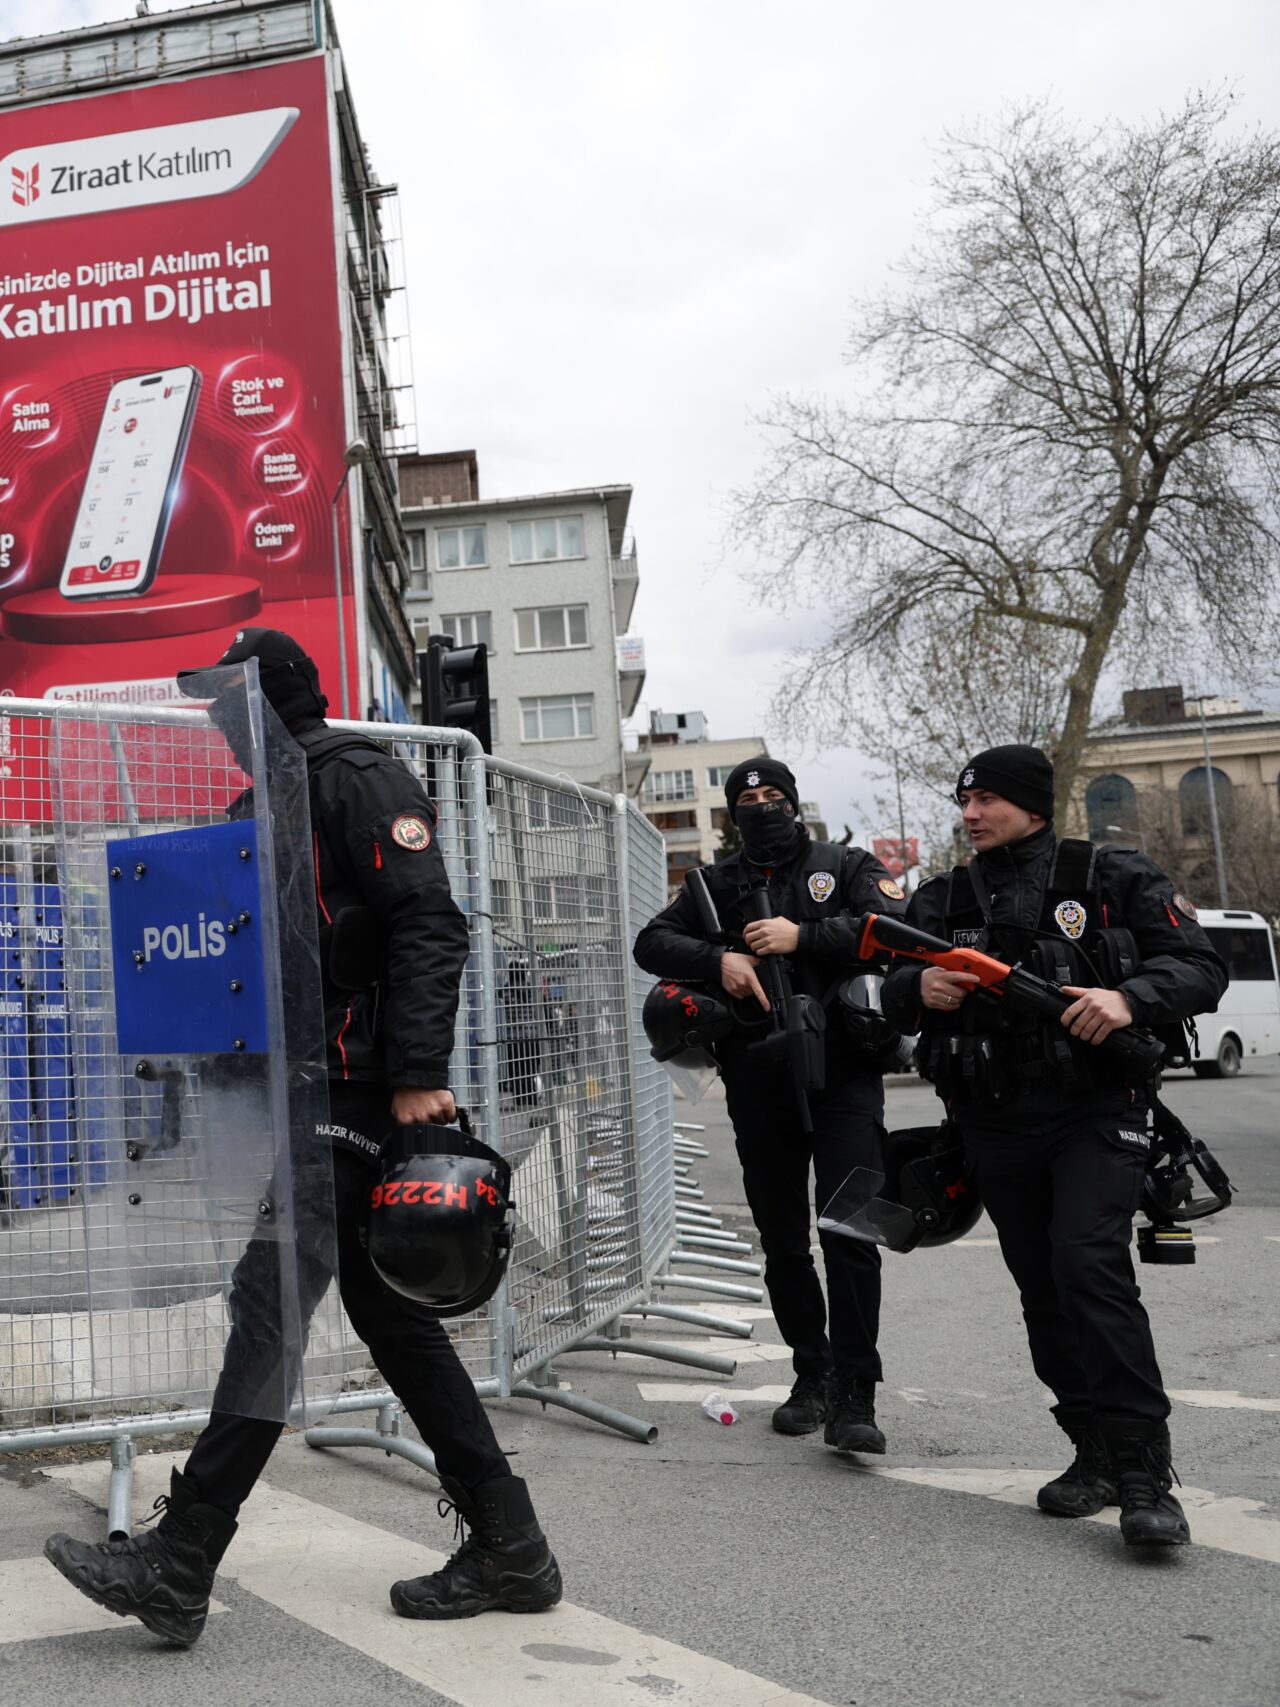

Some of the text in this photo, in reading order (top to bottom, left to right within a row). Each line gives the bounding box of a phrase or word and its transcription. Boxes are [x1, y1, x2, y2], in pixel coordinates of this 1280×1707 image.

[50, 146, 232, 195] Ziraat Katılım
[77, 257, 144, 287] Dijital
[150, 250, 221, 277] Atılım
[226, 241, 269, 268] İçin
[144, 269, 272, 323] Dijital
[232, 377, 284, 393] Stok ve
[233, 391, 261, 407] Cari
[12, 402, 50, 418] Satın
[234, 403, 274, 416] Yönetimi
[12, 417, 51, 433] Alma
[263, 453, 296, 464] Banka
[264, 464, 297, 476] Hesap
[254, 522, 295, 536] Ödeme
[256, 535, 282, 548] Linki
[144, 912, 226, 962] POLİS
[315, 1123, 381, 1157] HAZIR KUVVET
